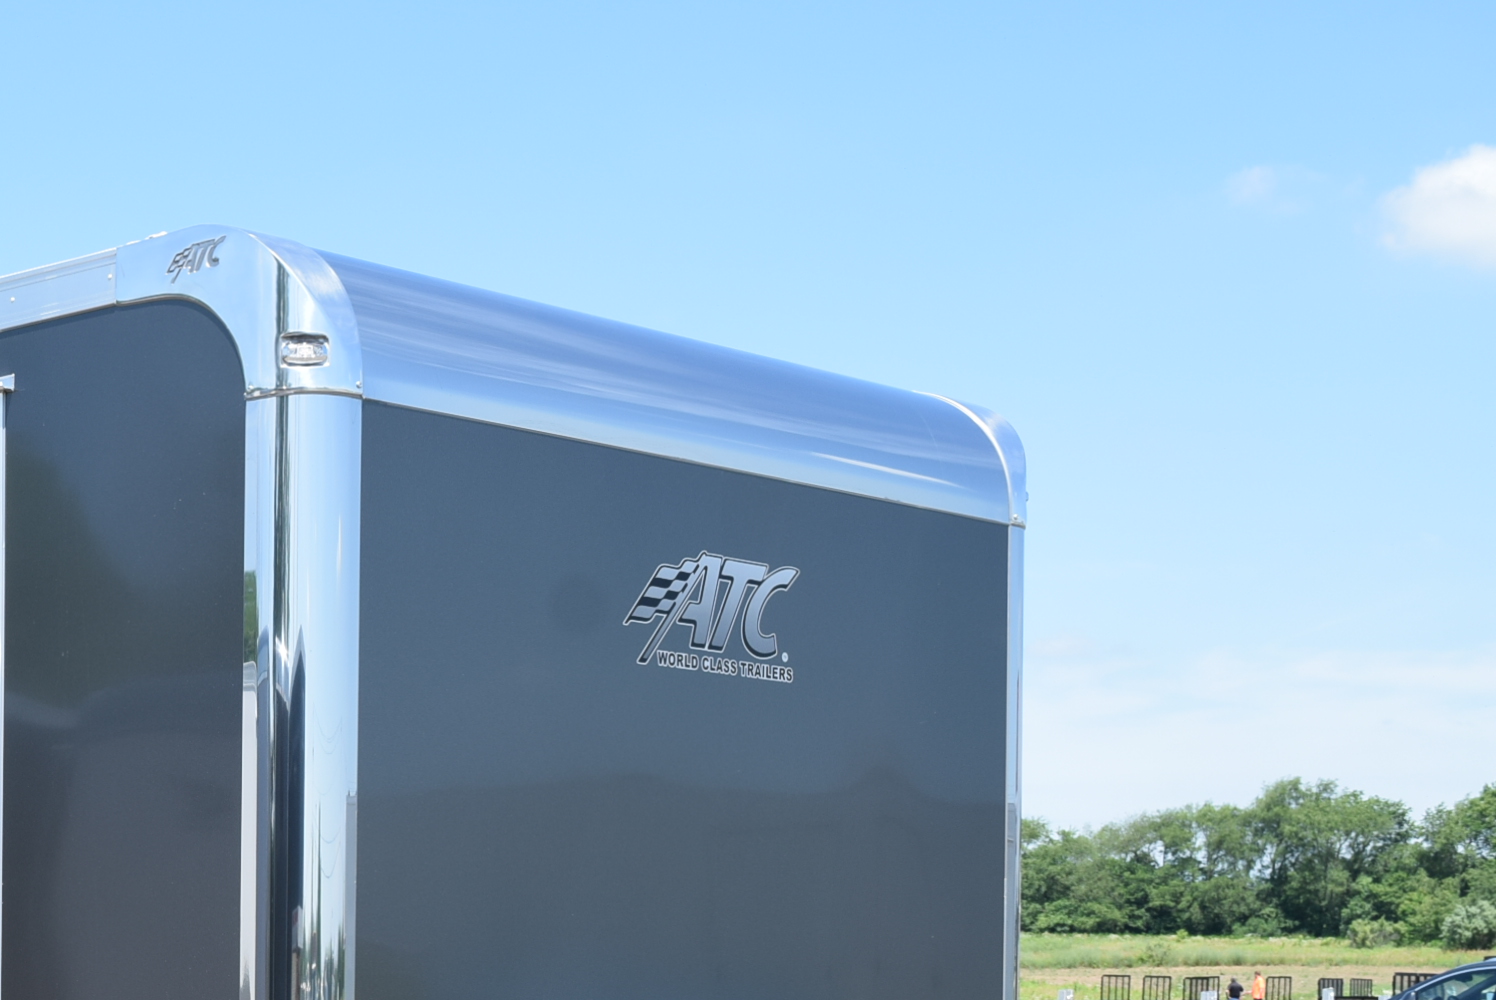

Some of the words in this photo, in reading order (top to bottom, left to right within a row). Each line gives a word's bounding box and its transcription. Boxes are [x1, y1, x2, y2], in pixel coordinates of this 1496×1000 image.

[168, 235, 226, 285] ATC
[632, 550, 800, 664] ATC
[656, 650, 699, 671] WORLD
[701, 656, 737, 676] CLASS
[739, 661, 794, 683] TRAILERS
